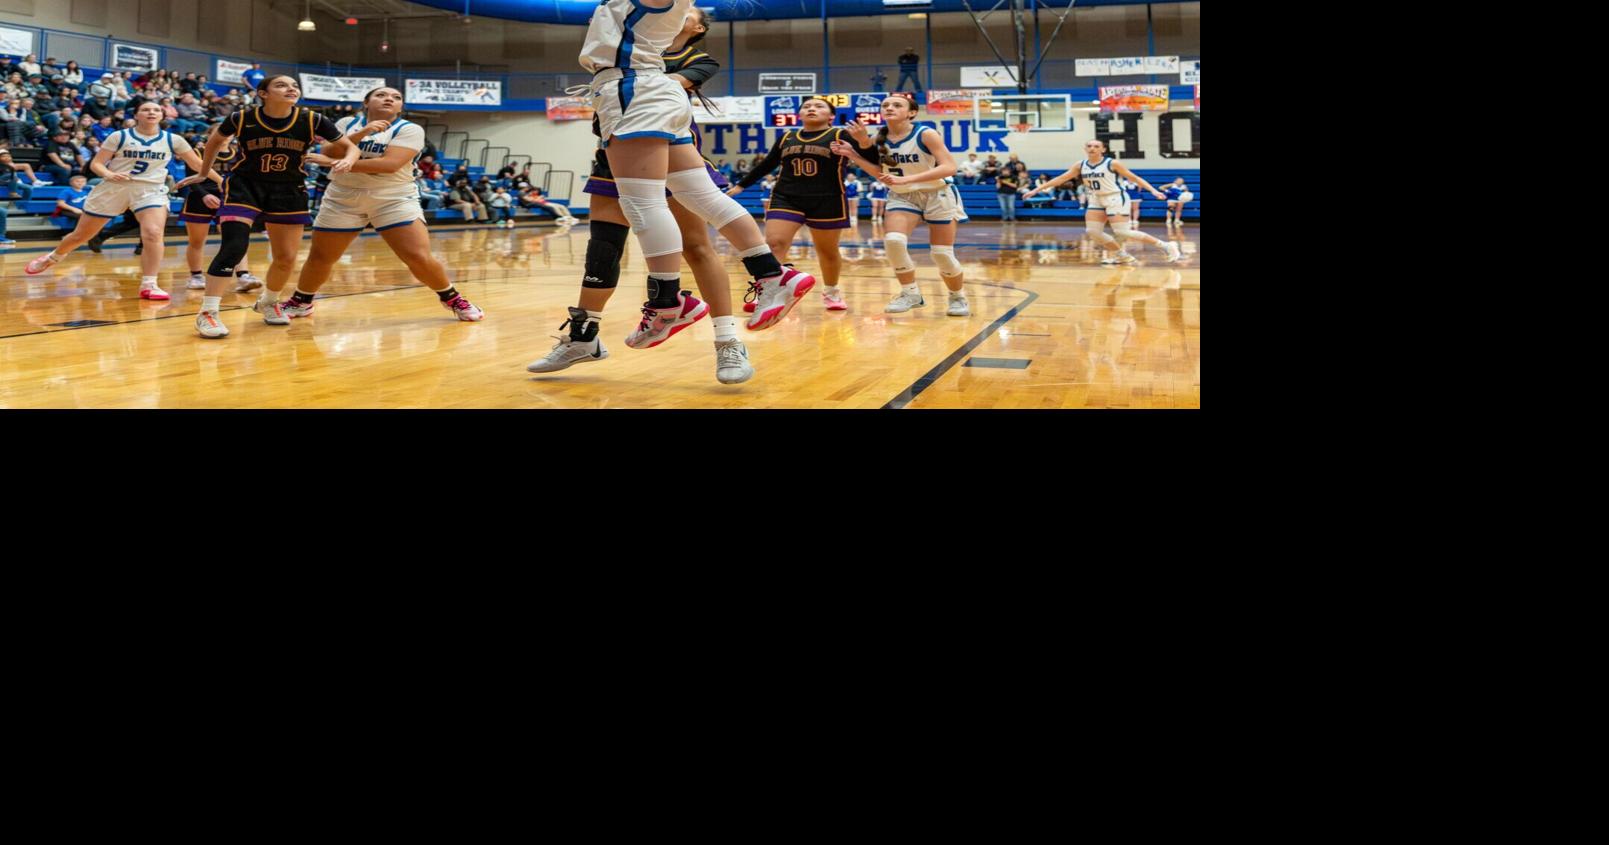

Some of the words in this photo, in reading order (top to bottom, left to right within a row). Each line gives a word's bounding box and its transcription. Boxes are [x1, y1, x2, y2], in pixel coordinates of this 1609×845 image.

[776, 114, 797, 126] 37
[859, 113, 880, 125] 24
[129, 160, 149, 175] 3
[260, 153, 290, 173] 13
[791, 157, 818, 177] 10
